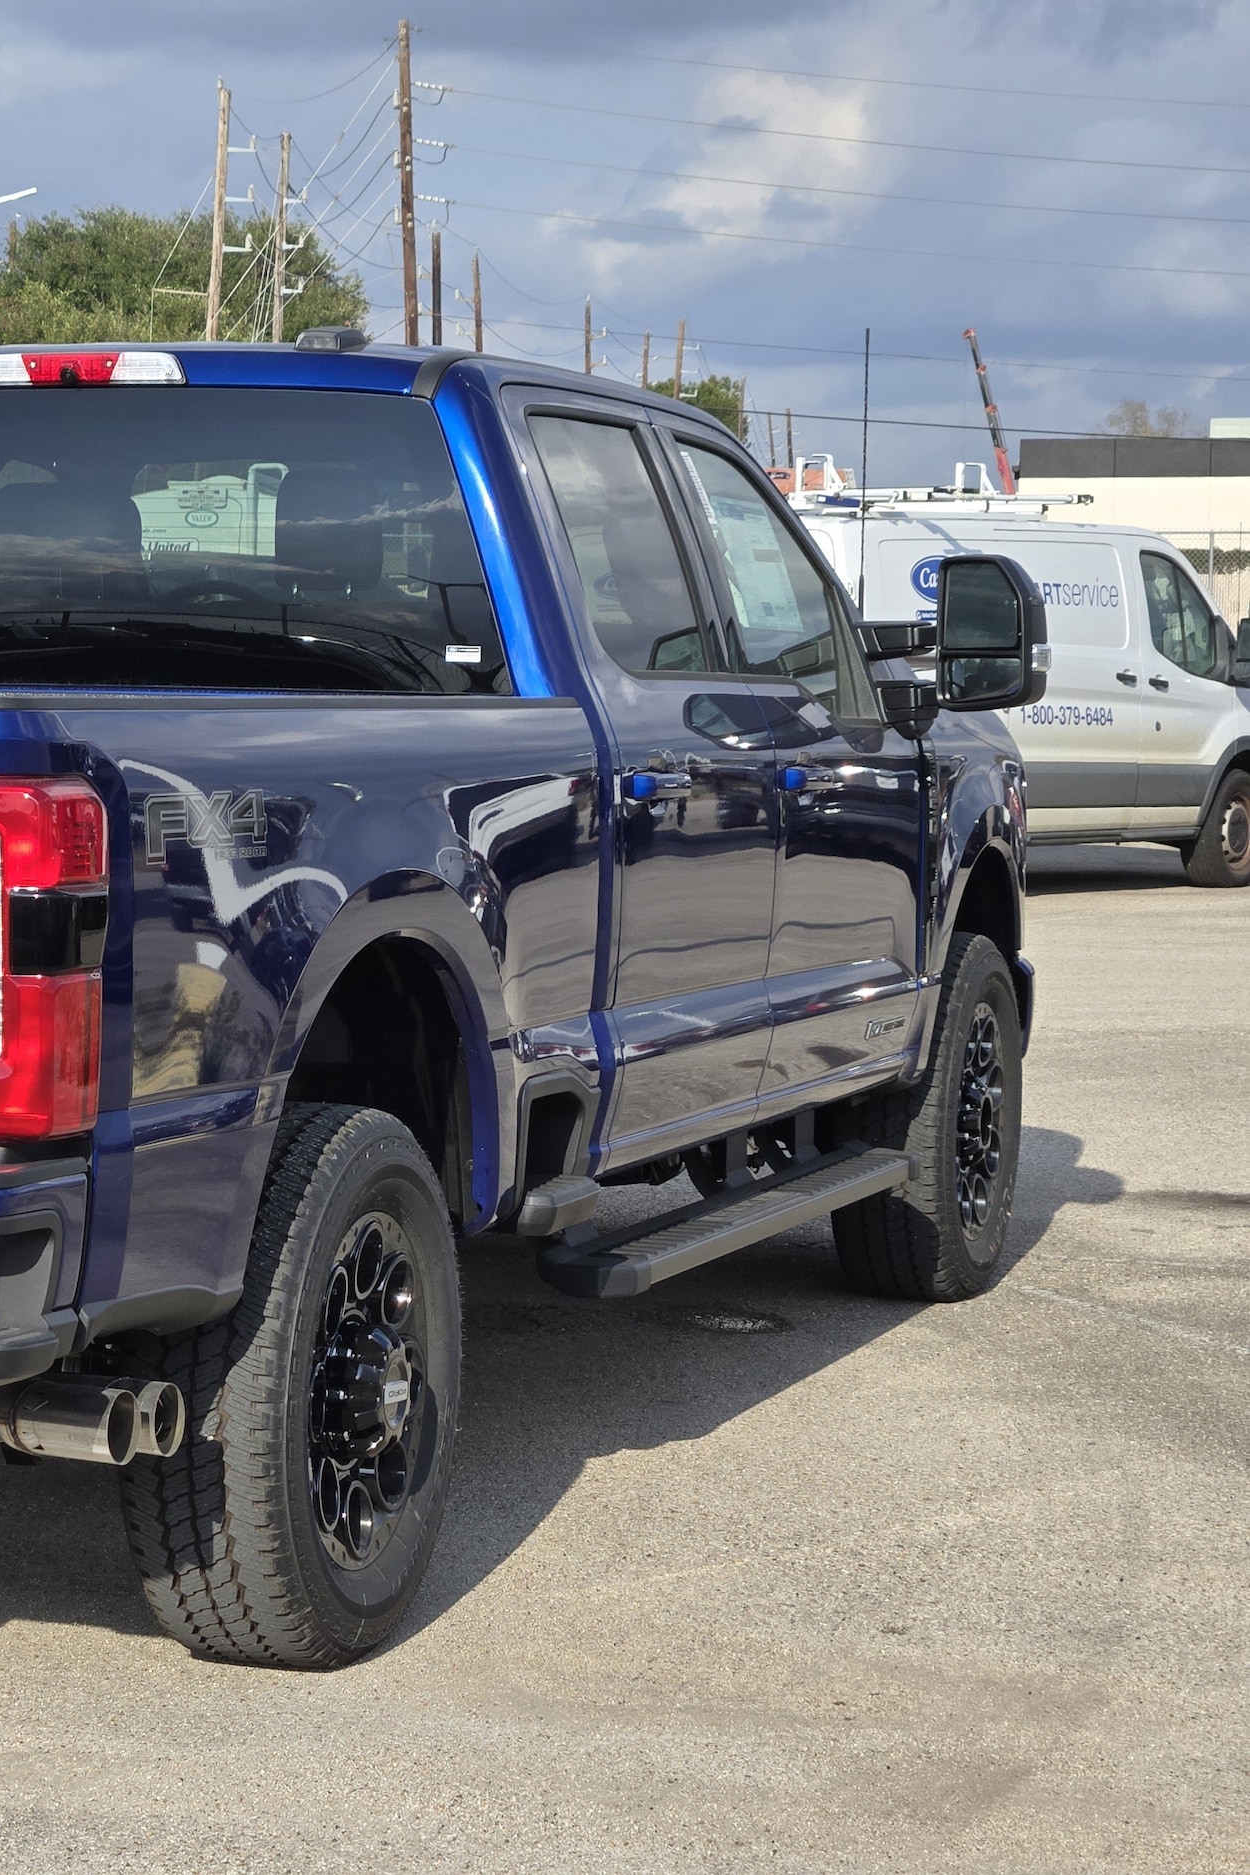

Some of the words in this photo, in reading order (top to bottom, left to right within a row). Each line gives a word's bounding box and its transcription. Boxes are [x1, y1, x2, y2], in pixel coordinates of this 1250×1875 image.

[148, 541, 191, 552] United
[1020, 705, 1113, 726] 1-800-379-6484
[145, 790, 267, 864] FX4
